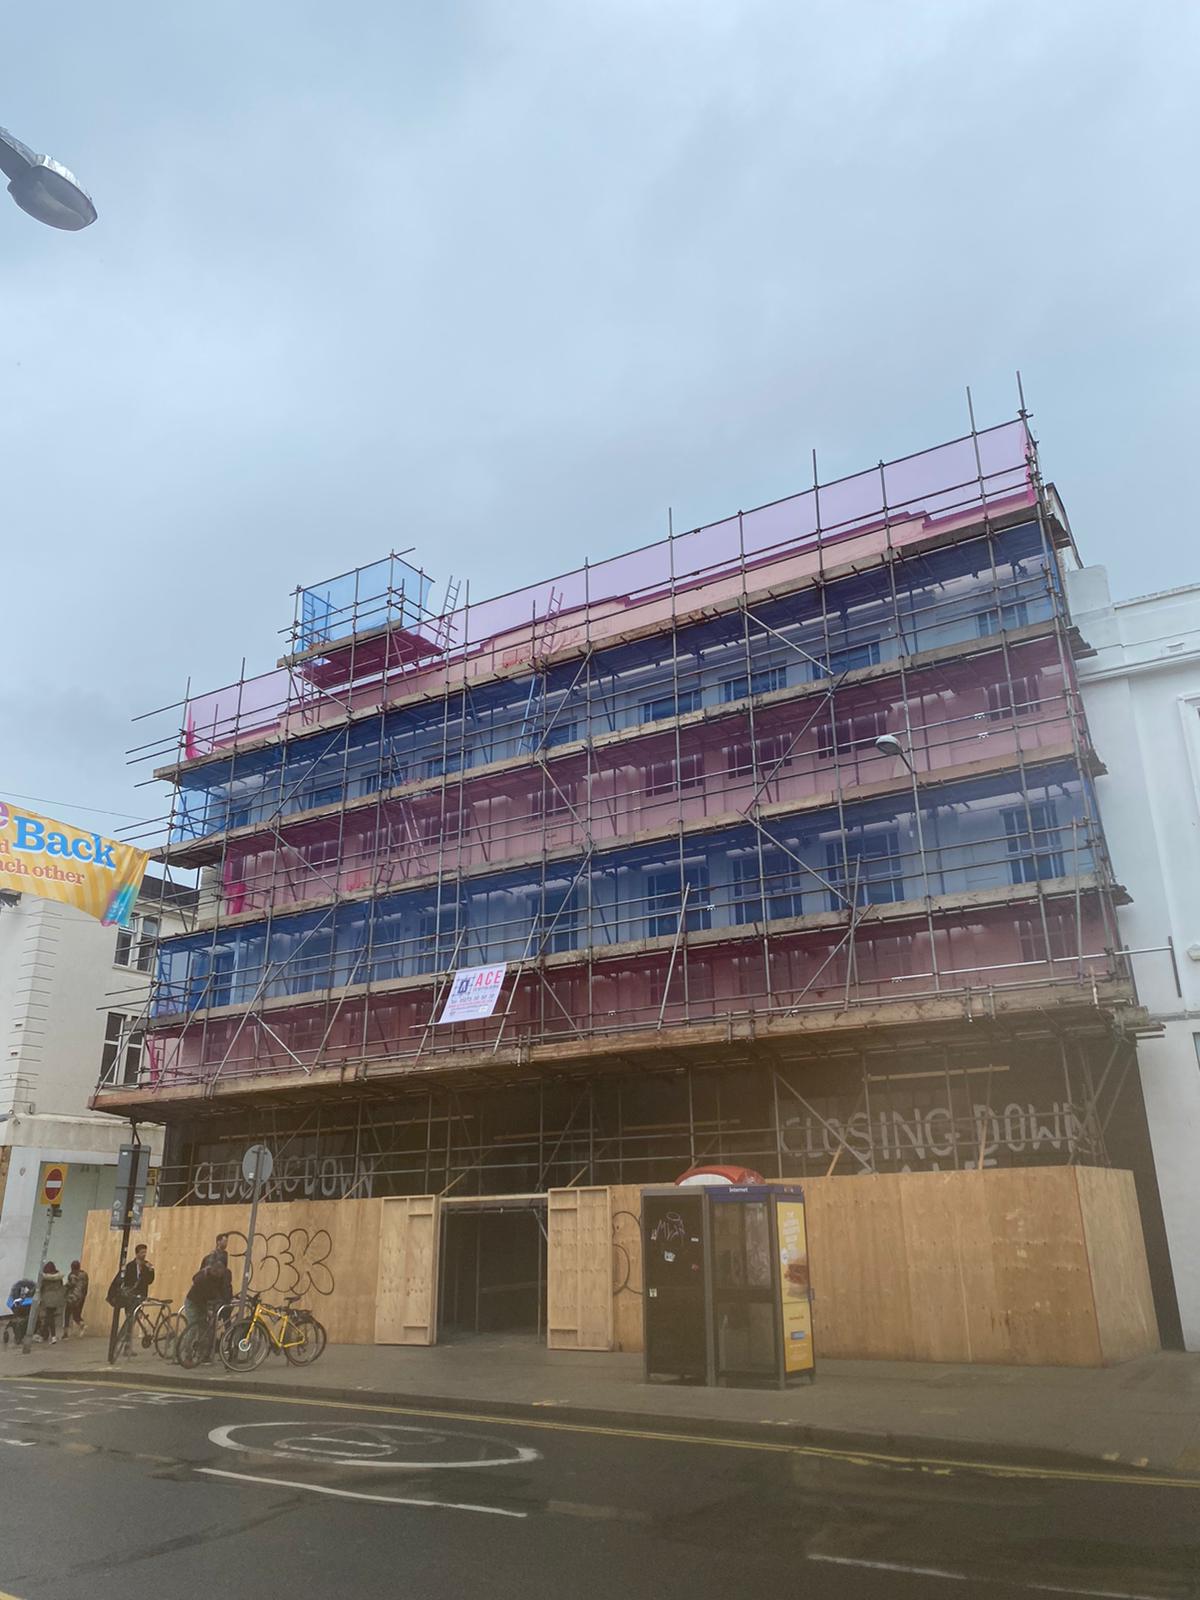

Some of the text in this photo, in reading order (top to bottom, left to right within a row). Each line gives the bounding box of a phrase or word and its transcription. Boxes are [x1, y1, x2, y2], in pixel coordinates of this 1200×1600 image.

[13, 815, 116, 869] Back
[33, 863, 85, 884] other
[476, 970, 501, 985] ACE
[780, 1102, 1088, 1161] CLOSING DOWN
